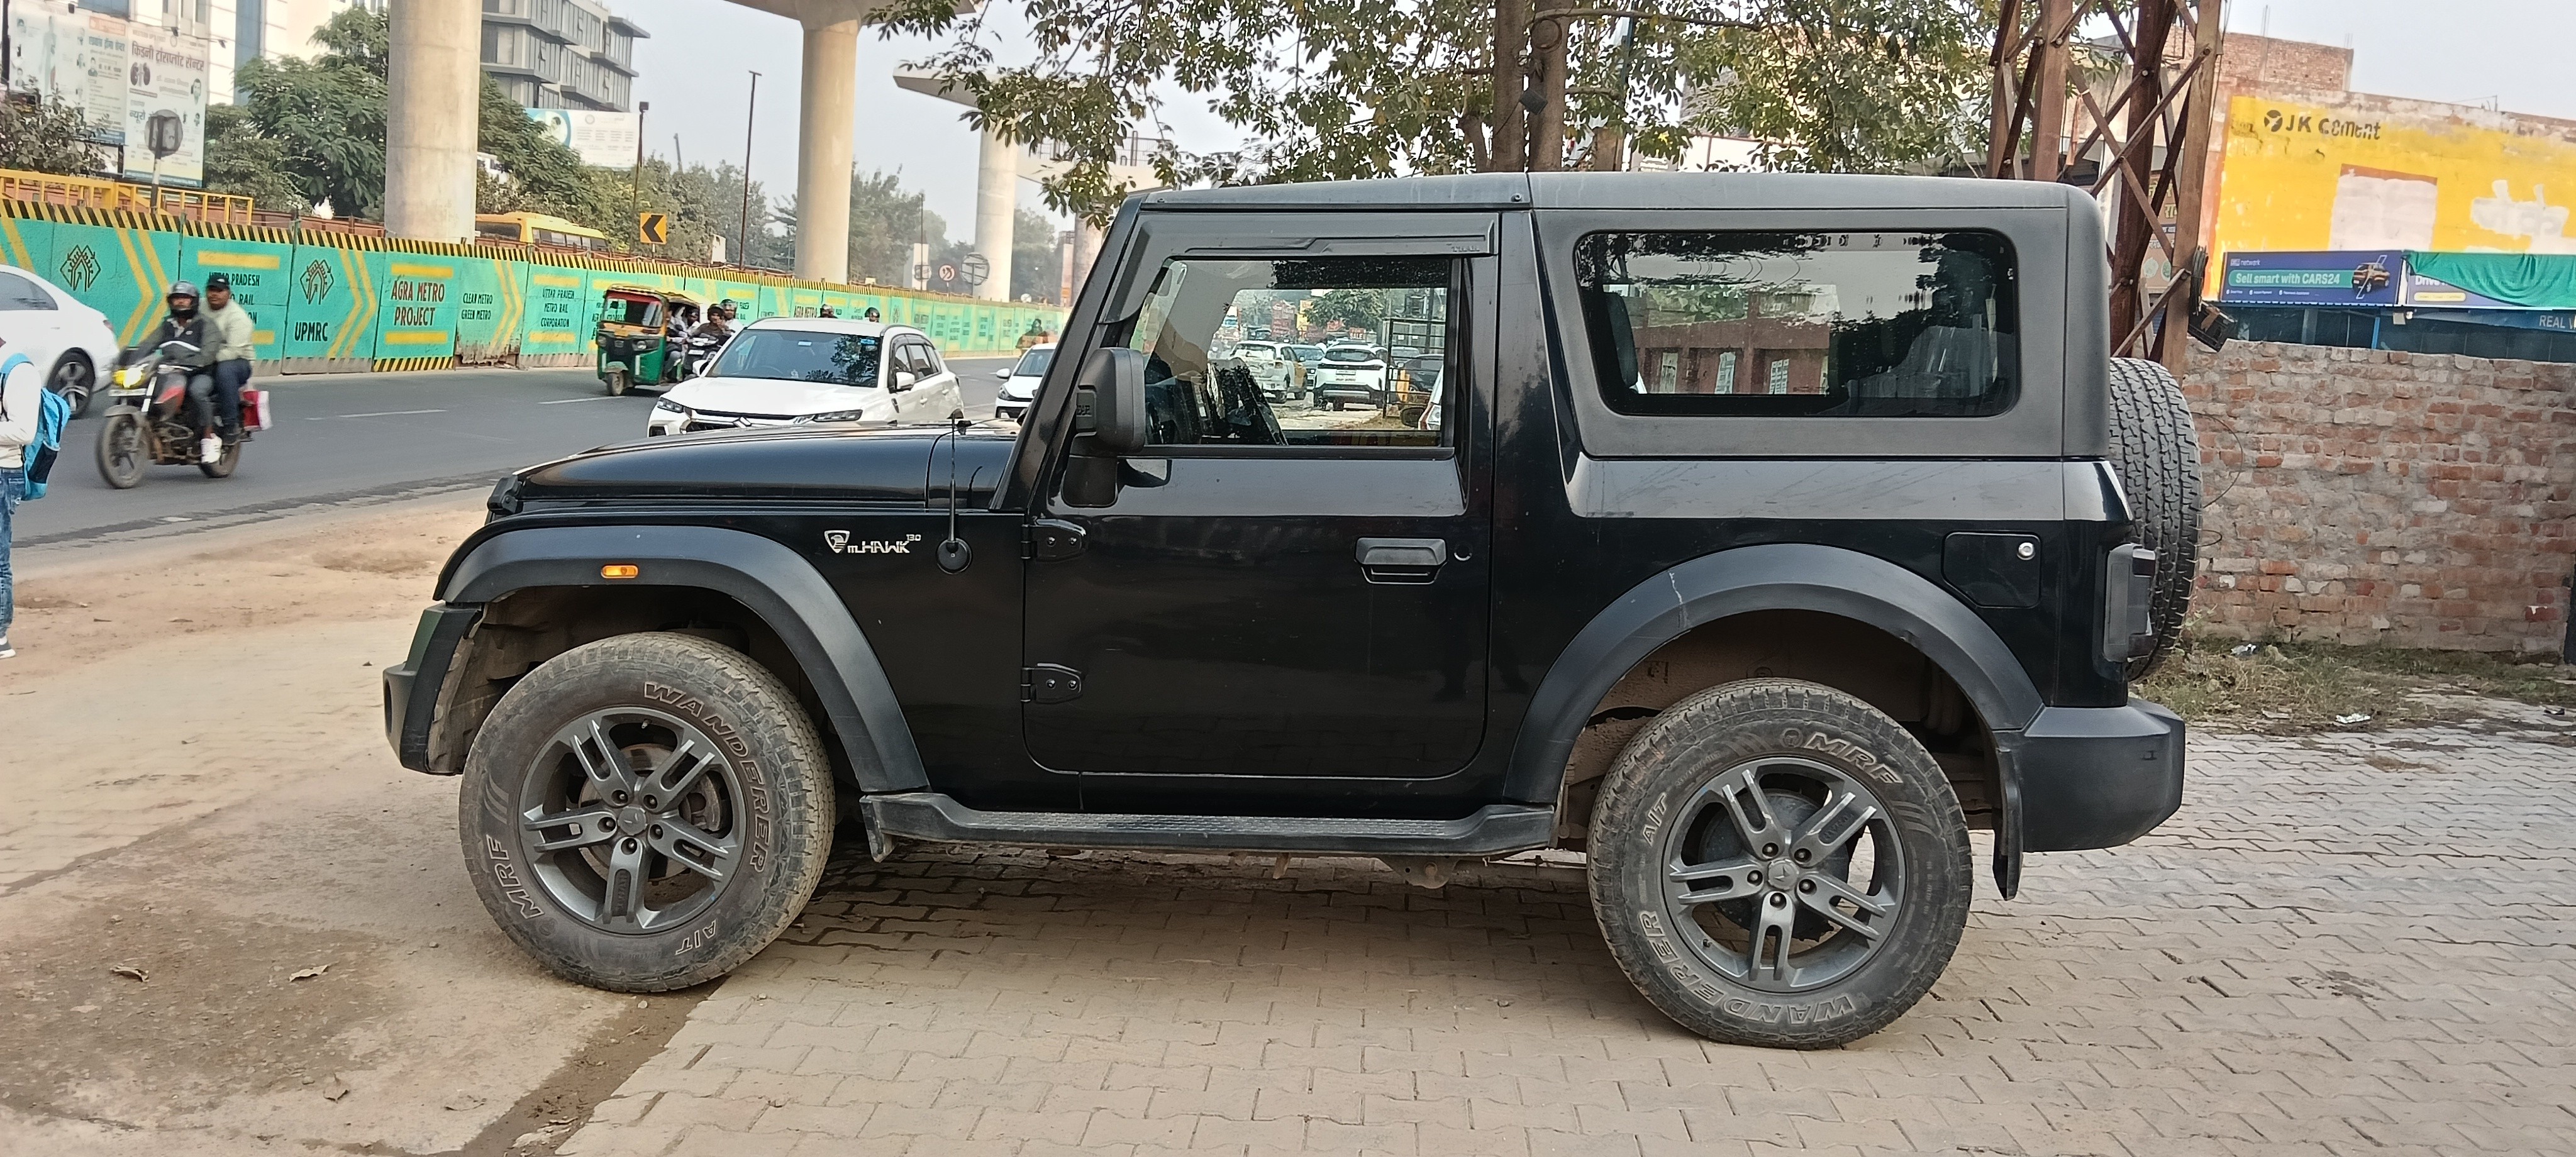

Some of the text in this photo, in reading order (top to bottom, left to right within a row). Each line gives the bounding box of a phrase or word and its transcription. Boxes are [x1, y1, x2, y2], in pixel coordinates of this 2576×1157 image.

[132, 40, 153, 60] किडनी
[2285, 114, 2381, 140] JK Cement
[231, 273, 260, 286] PRADESH
[2236, 273, 2340, 284] Sell smart with CARS24
[238, 294, 254, 305] RAIL
[391, 280, 445, 302] AGRA METRO
[477, 294, 493, 305] METRO
[394, 306, 436, 326] PROJECT
[476, 310, 491, 320] METRO
[2539, 314, 2566, 328] REAL
[294, 322, 328, 341] UPMRC
[1805, 732, 1904, 784] MRF
[644, 681, 772, 873] WANDERER
[486, 834, 545, 919] MRF
[1638, 911, 1856, 1025] WANDERER
